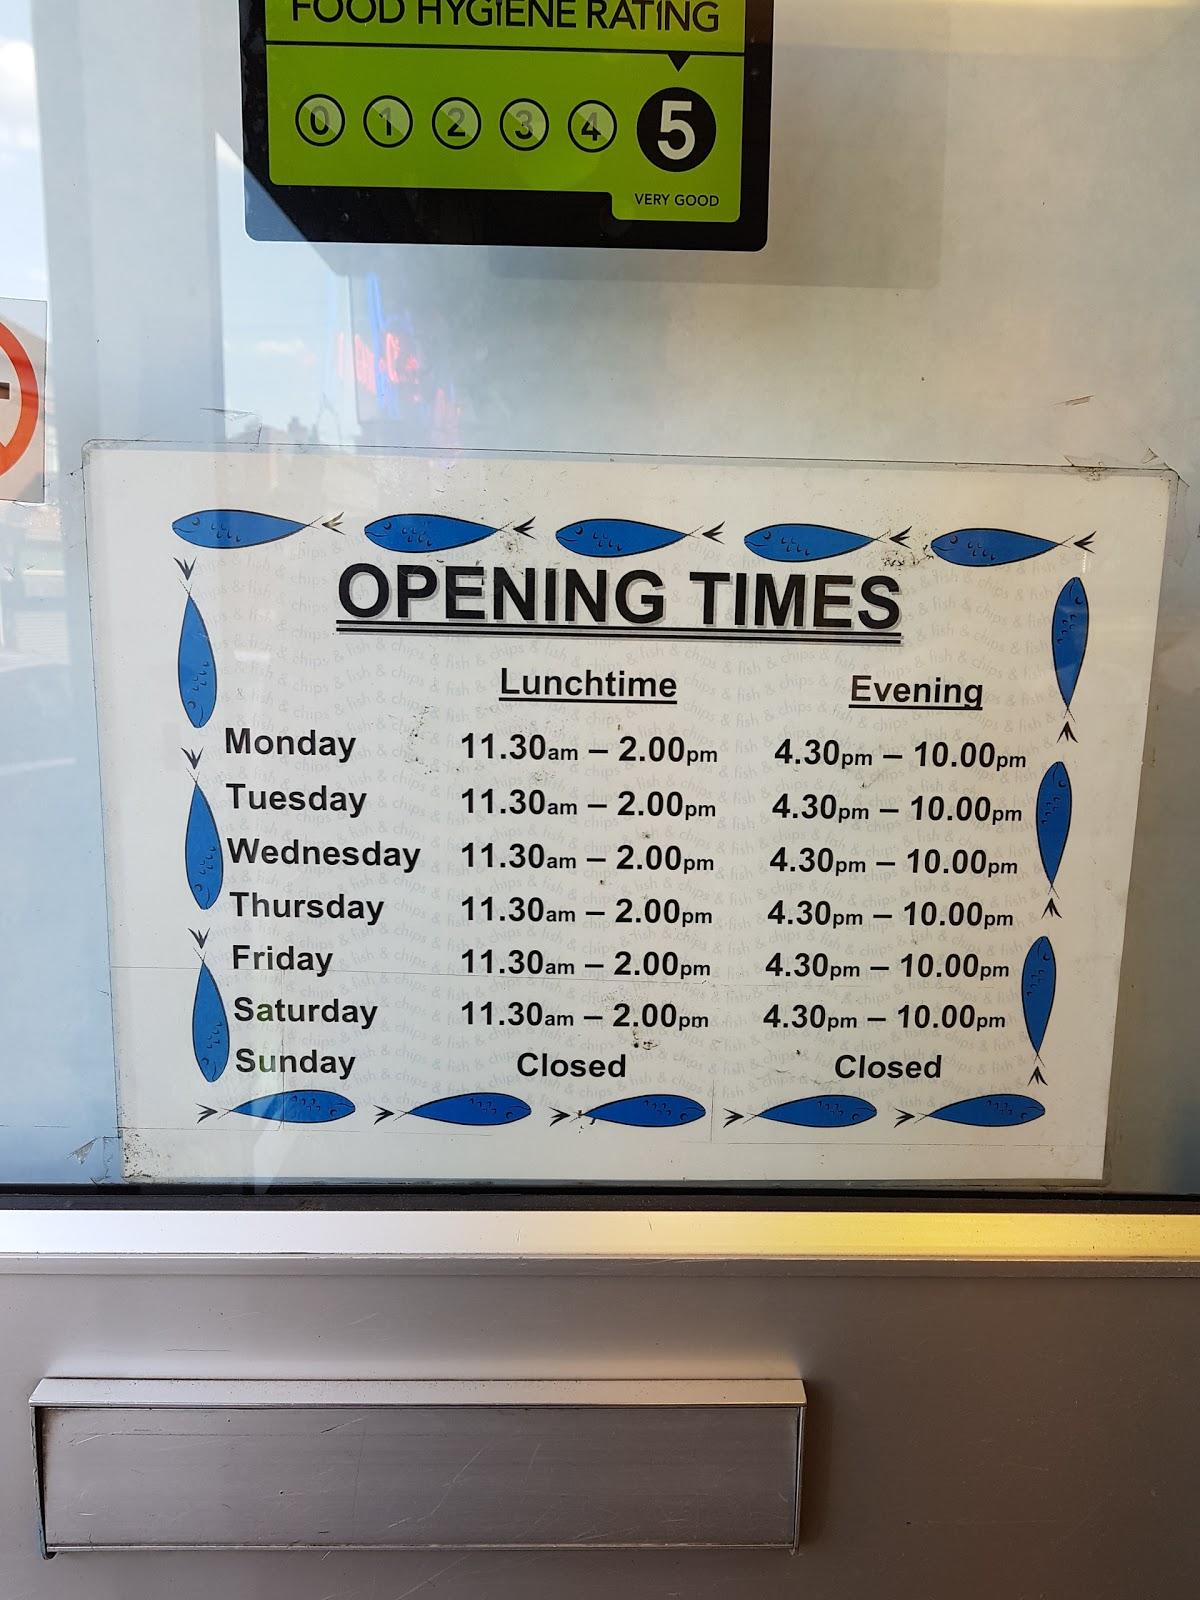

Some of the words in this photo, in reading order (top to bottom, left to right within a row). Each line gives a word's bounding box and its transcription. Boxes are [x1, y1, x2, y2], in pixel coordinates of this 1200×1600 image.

[293, 0, 405, 23] FOOD
[418, 0, 576, 28] HYGIENE
[587, 0, 719, 32] RATING
[308, 105, 330, 137] 0
[378, 106, 394, 137] 1
[446, 106, 467, 138] 2
[513, 109, 534, 141] 3
[580, 111, 602, 142] 4
[657, 100, 696, 161] 5
[634, 192, 670, 207] VERY
[674, 193, 720, 208] GOOD
[338, 562, 666, 626] OPENING
[689, 571, 901, 631] TIMES
[500, 667, 678, 699] Lunchtime
[850, 674, 984, 710] Evening
[226, 728, 356, 763] Monday
[462, 733, 577, 760] 11.30am
[619, 736, 717, 766] 2.00pm
[775, 739, 872, 769] 4.30pm
[915, 741, 1026, 771] 10.00pm
[226, 783, 367, 818] Tuesday
[462, 788, 577, 815] 11.30am
[618, 791, 715, 820] 2.00pm
[772, 794, 868, 823] 4.30pm
[911, 796, 1022, 825] 10.00pm
[227, 838, 421, 873] Wednesday
[462, 843, 576, 868] 11.30am
[617, 845, 713, 874] 2.00pm
[770, 847, 865, 876] 4.30pm
[908, 849, 1017, 877] 10.00pm
[230, 892, 384, 925] Thursday
[462, 896, 575, 922] 11.30am
[616, 898, 712, 927] 2.00pm
[768, 900, 862, 929] 4.30pm
[904, 902, 1013, 929] 10.00pm
[233, 945, 333, 977] Friday
[462, 949, 574, 974] 11.30am
[614, 951, 710, 979] 2.00pm
[766, 953, 859, 980] 4.30pm
[901, 954, 1009, 981] 10.00pm
[235, 997, 377, 1029] Saturday
[462, 1001, 573, 1026] 11.30am
[613, 1003, 708, 1031] 2.00pm
[763, 1004, 857, 1032] 4.30pm
[898, 1005, 1005, 1031] 10.00pm
[236, 1049, 355, 1080] Sunday
[517, 1053, 627, 1078] Closed
[835, 1055, 942, 1079] Closed
